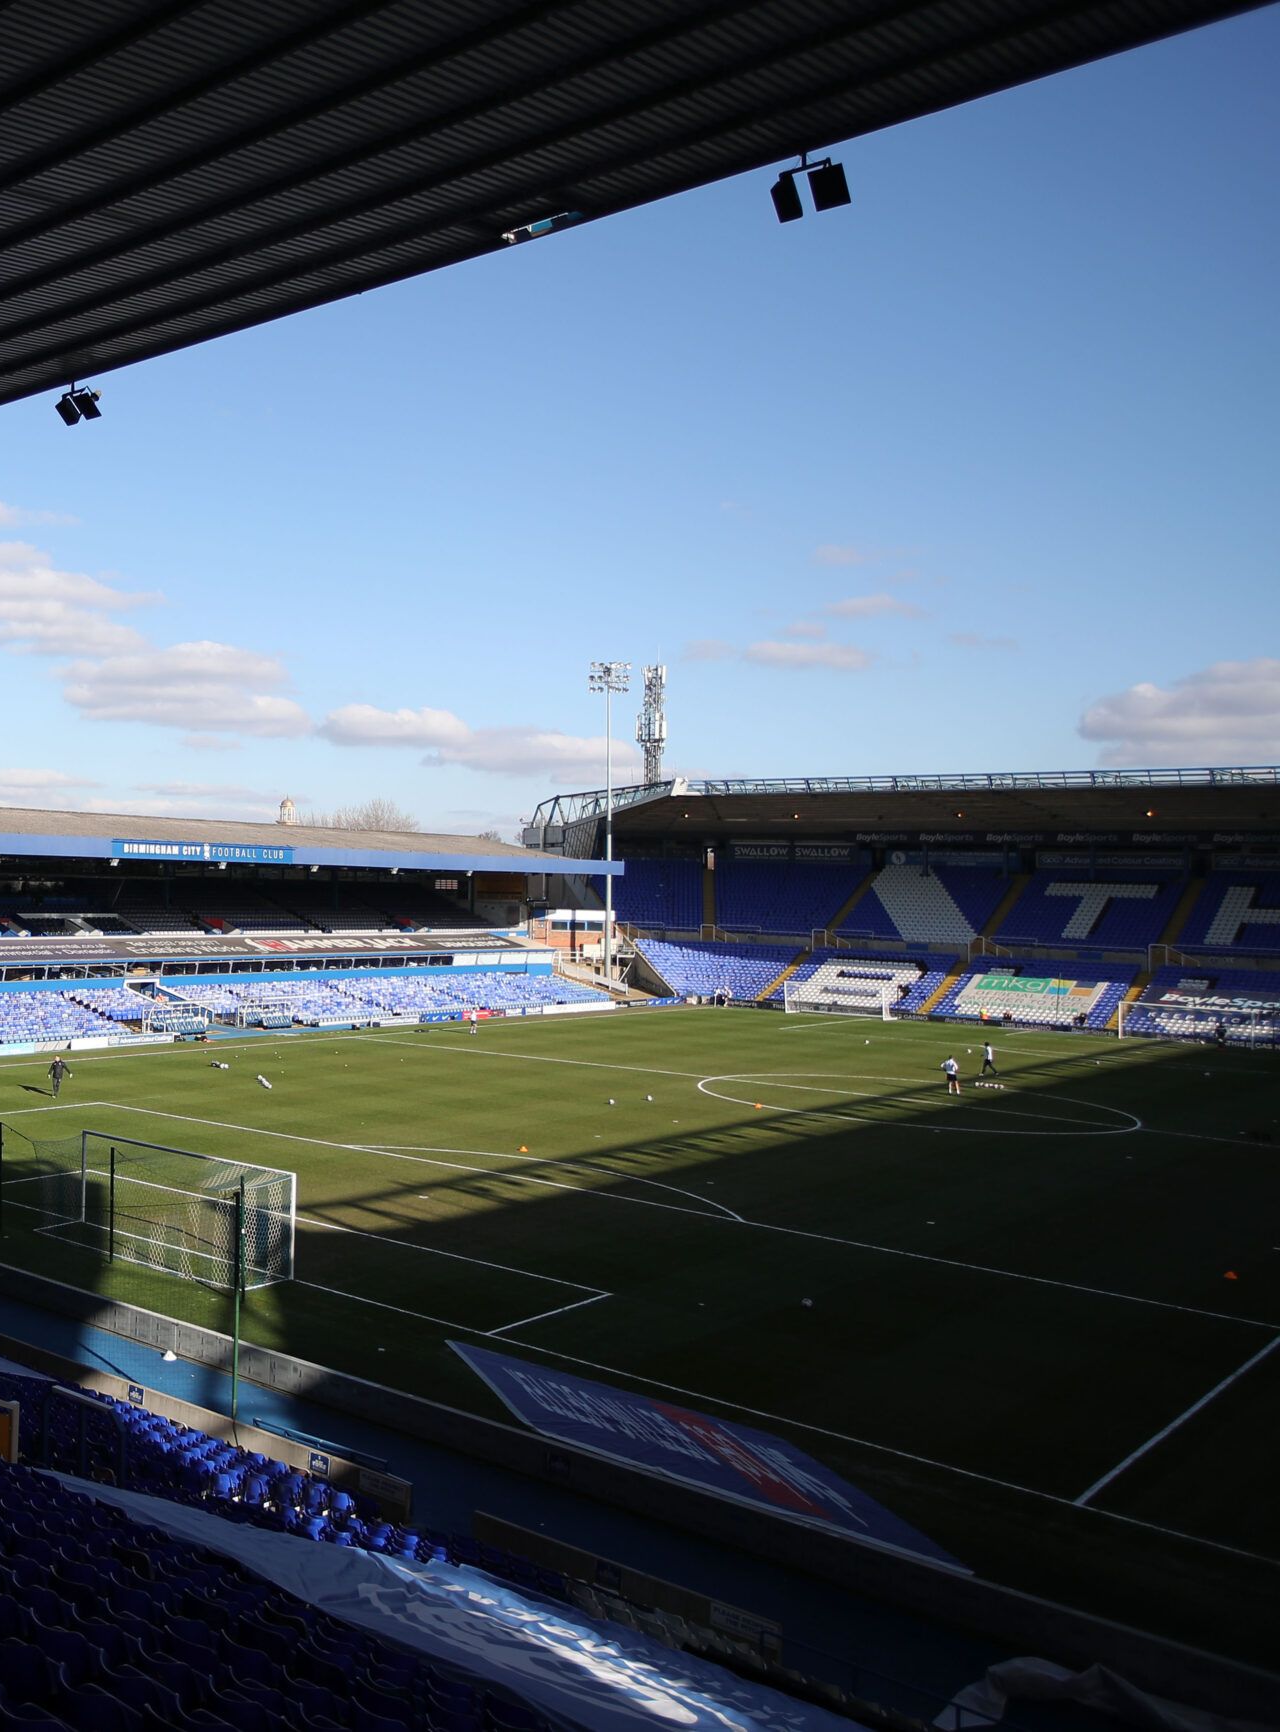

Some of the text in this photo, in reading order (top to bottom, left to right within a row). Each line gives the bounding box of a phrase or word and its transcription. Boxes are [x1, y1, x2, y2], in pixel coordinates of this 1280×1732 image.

[123, 843, 284, 859] BIRMINGHAM CITY FOOTBALL CLUB
[734, 847, 789, 856] SWALLOW
[794, 847, 850, 857] SWALLOW
[980, 978, 1046, 992] mkg
